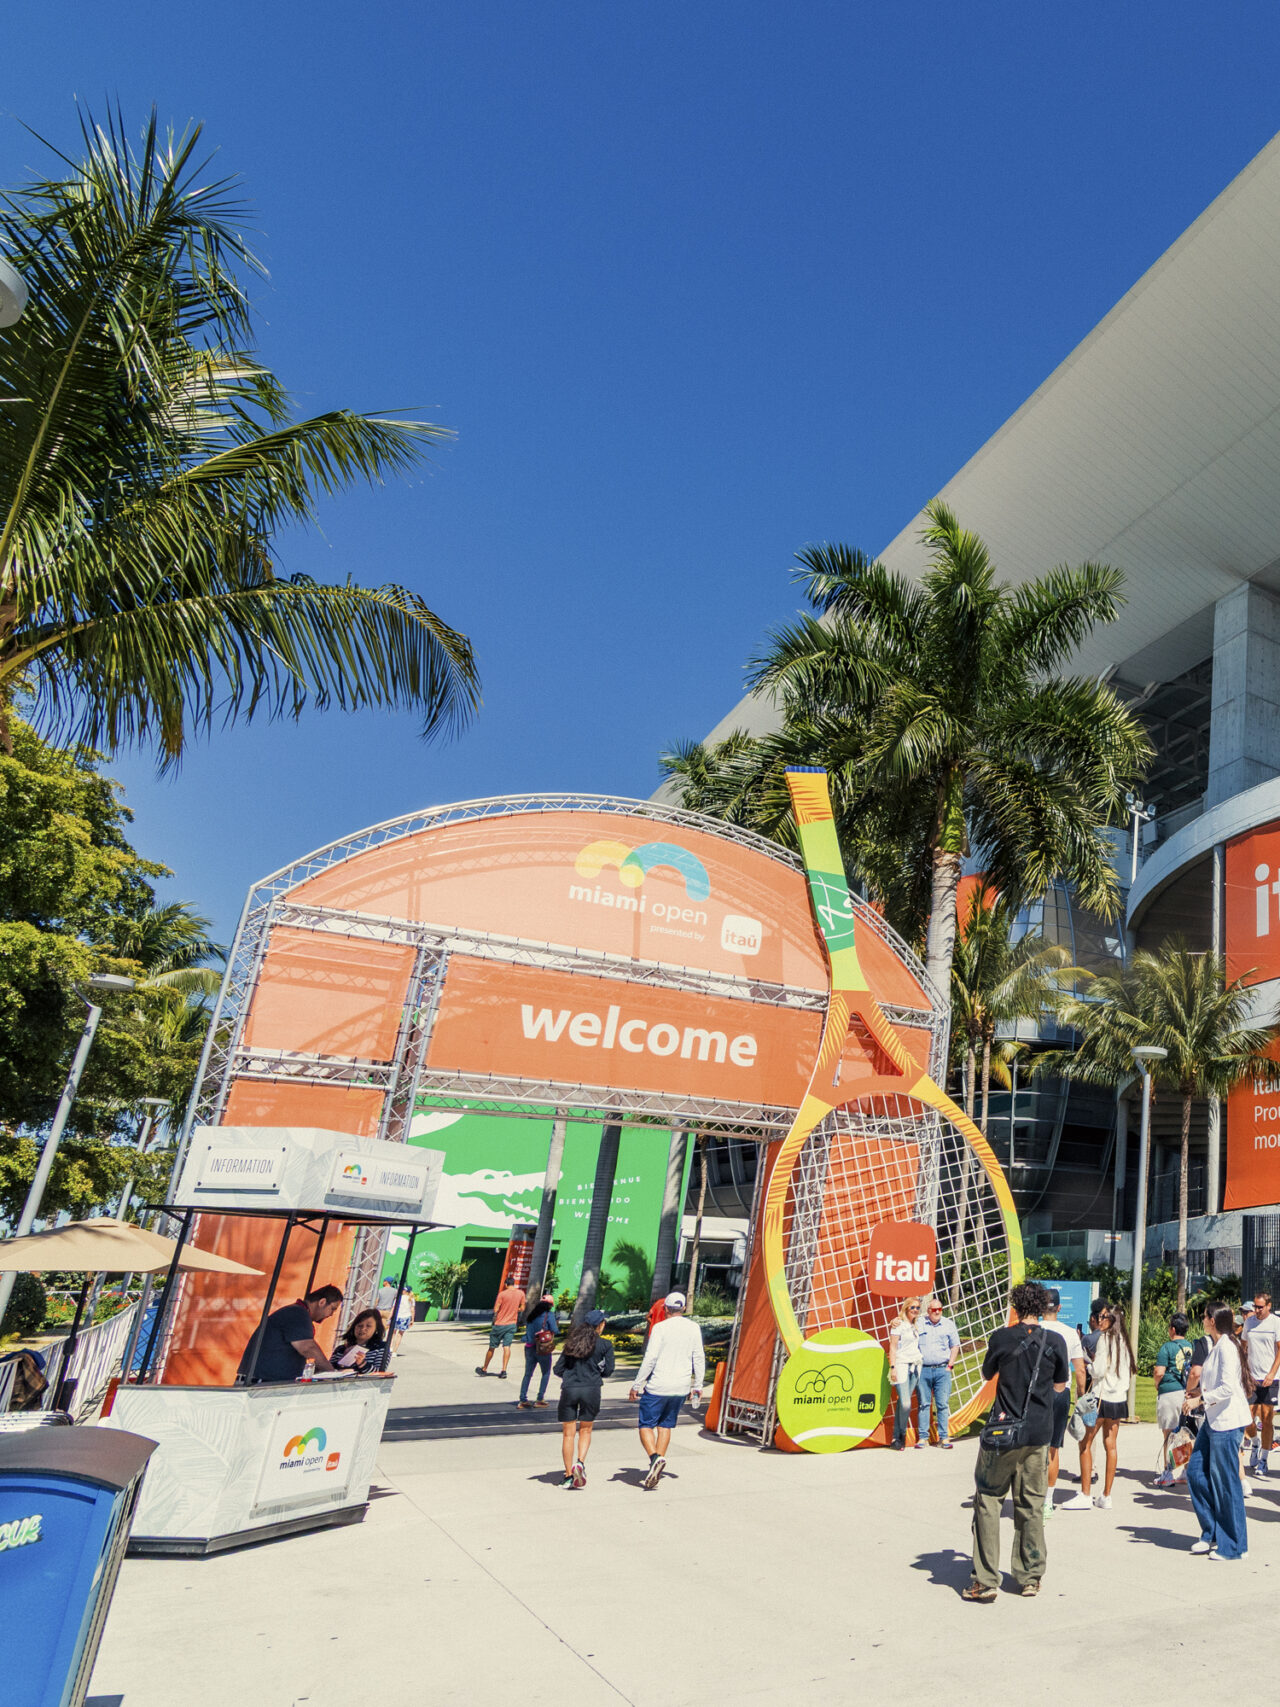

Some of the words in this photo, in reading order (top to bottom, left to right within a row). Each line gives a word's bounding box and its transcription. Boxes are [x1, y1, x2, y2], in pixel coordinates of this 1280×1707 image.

[568, 884, 647, 913] miami
[652, 902, 708, 926] open
[650, 924, 693, 940] presented
[693, 930, 705, 942] by
[724, 930, 757, 949] itaú
[521, 1004, 758, 1067] welcome
[210, 1158, 274, 1174] INFORMATION
[379, 1171, 420, 1189] INFORMATION
[574, 1211, 629, 1224] WEOME
[875, 1251, 930, 1282] itaú
[793, 1394, 826, 1405] miami
[827, 1394, 852, 1406] open
[280, 1457, 304, 1470] miami
[304, 1456, 323, 1467] open
